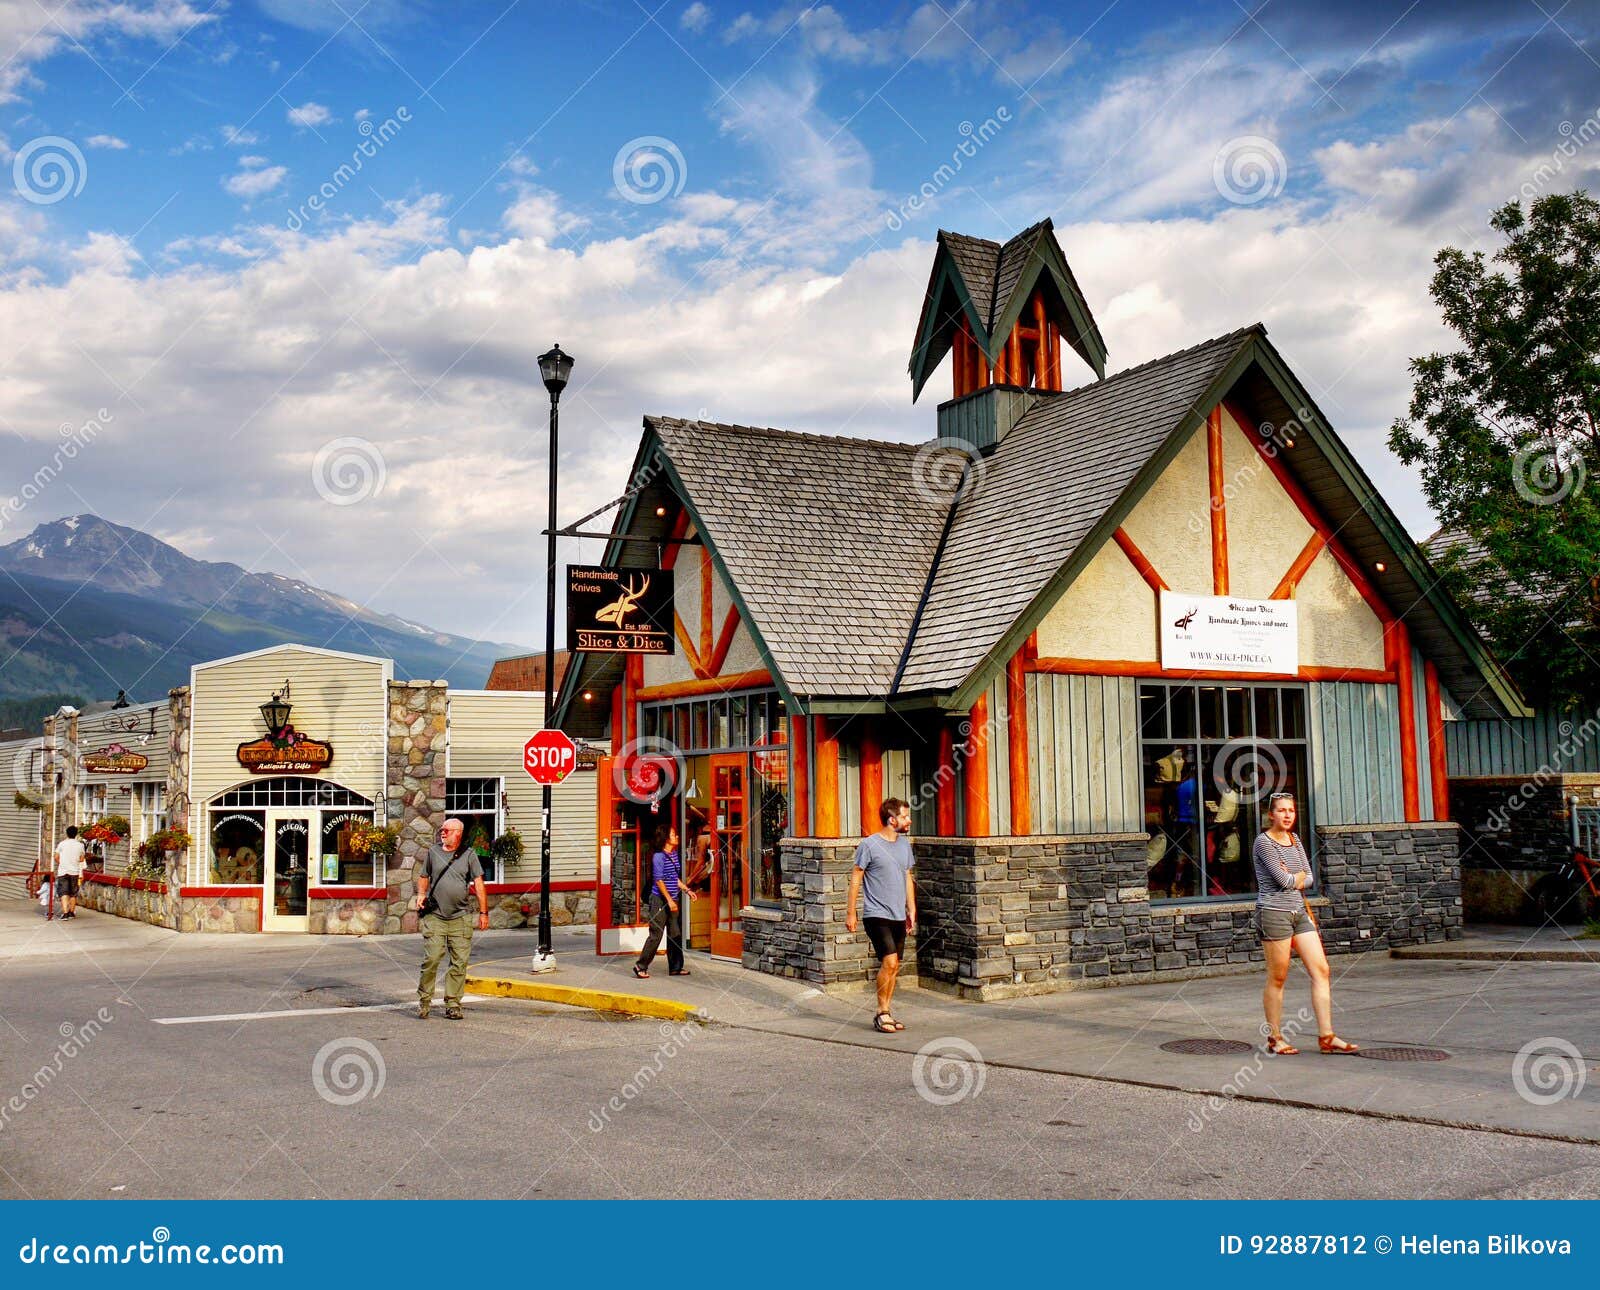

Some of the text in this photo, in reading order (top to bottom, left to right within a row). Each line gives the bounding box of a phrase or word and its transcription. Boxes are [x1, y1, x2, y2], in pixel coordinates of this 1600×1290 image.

[571, 569, 618, 580] Handmade
[571, 583, 601, 593] Knives
[578, 633, 664, 649] Slice & Dice
[527, 746, 573, 768] STOP
[277, 823, 308, 835] WELCOME
[323, 813, 349, 835] ELYSION
